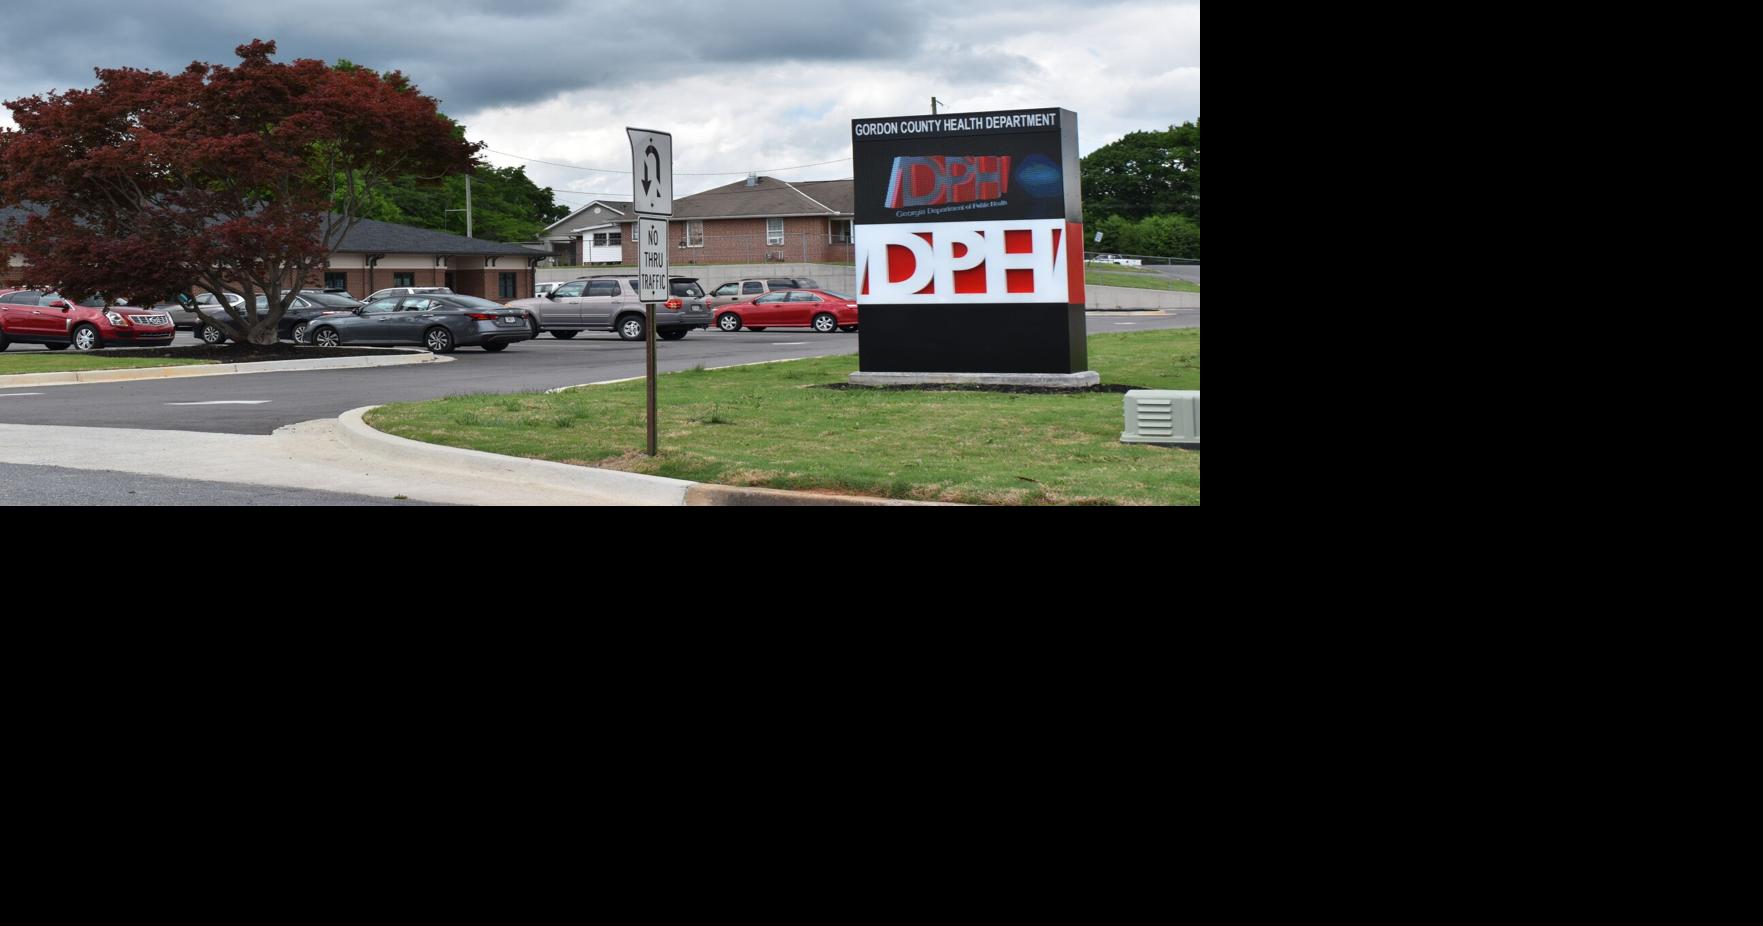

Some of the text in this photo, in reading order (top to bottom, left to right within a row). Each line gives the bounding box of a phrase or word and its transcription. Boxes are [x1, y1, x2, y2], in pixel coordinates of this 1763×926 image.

[855, 113, 1056, 136] GORDON COUNTY HEALTH DEPARTMENT
[901, 155, 1002, 206] DPH
[896, 209, 926, 217] Georgia
[927, 205, 964, 214] Department
[972, 202, 989, 210] Public
[648, 230, 658, 245] NO
[644, 252, 663, 267] THRU
[868, 229, 1054, 296] DPH
[641, 274, 666, 289] TRAFFIC
